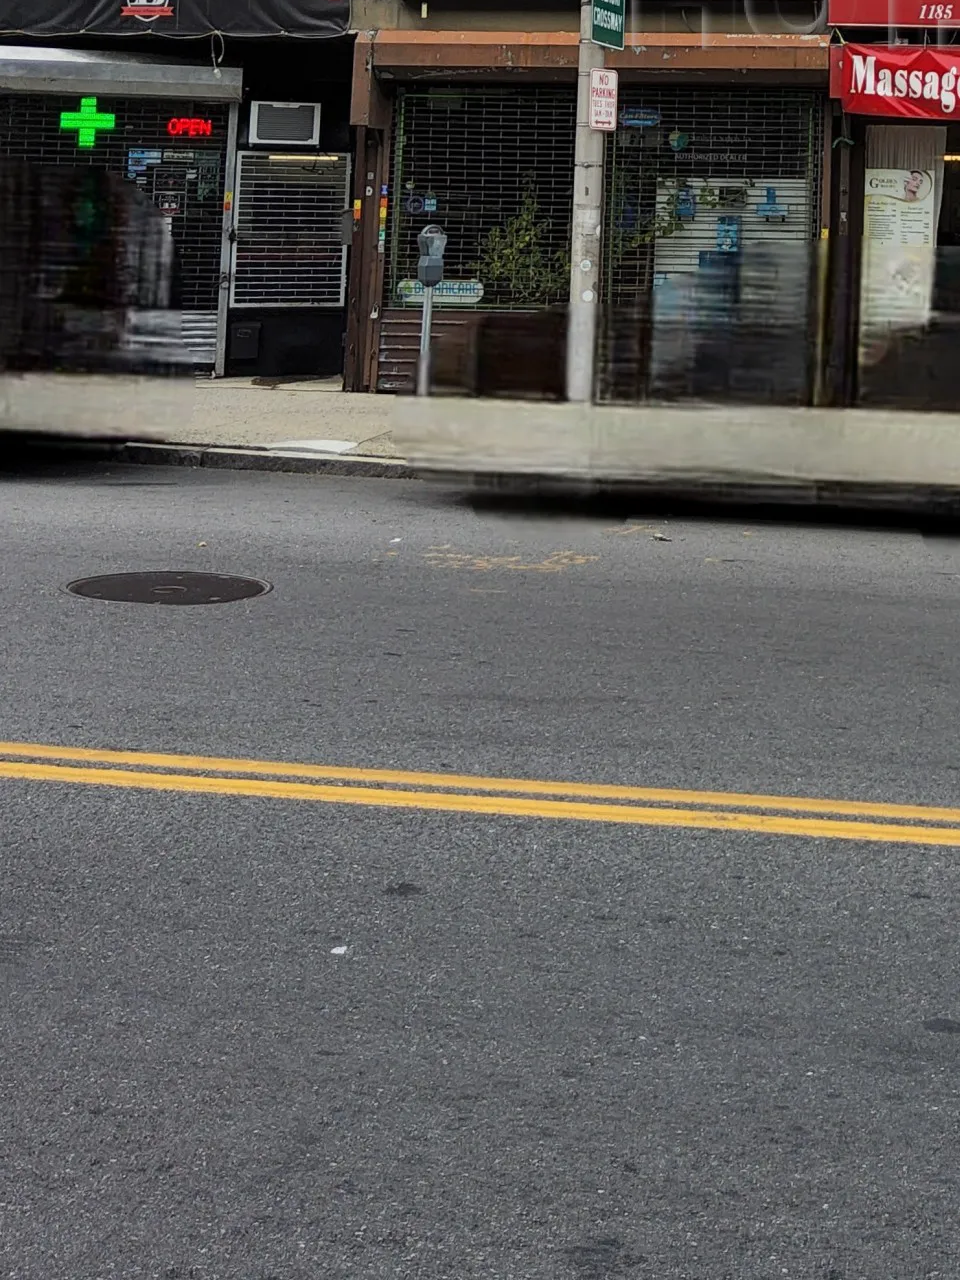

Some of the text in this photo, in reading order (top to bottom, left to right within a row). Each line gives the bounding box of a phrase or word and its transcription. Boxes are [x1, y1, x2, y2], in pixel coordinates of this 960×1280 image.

[919, 4, 953, 20] 1185
[593, 8, 622, 32] CROSSWAY
[599, 73, 609, 86] NO
[592, 87, 616, 100] PARKING
[168, 117, 213, 137] OPEN
[675, 153, 747, 162] AUTHORIZED DEALER
[414, 282, 479, 294] BANICARE
